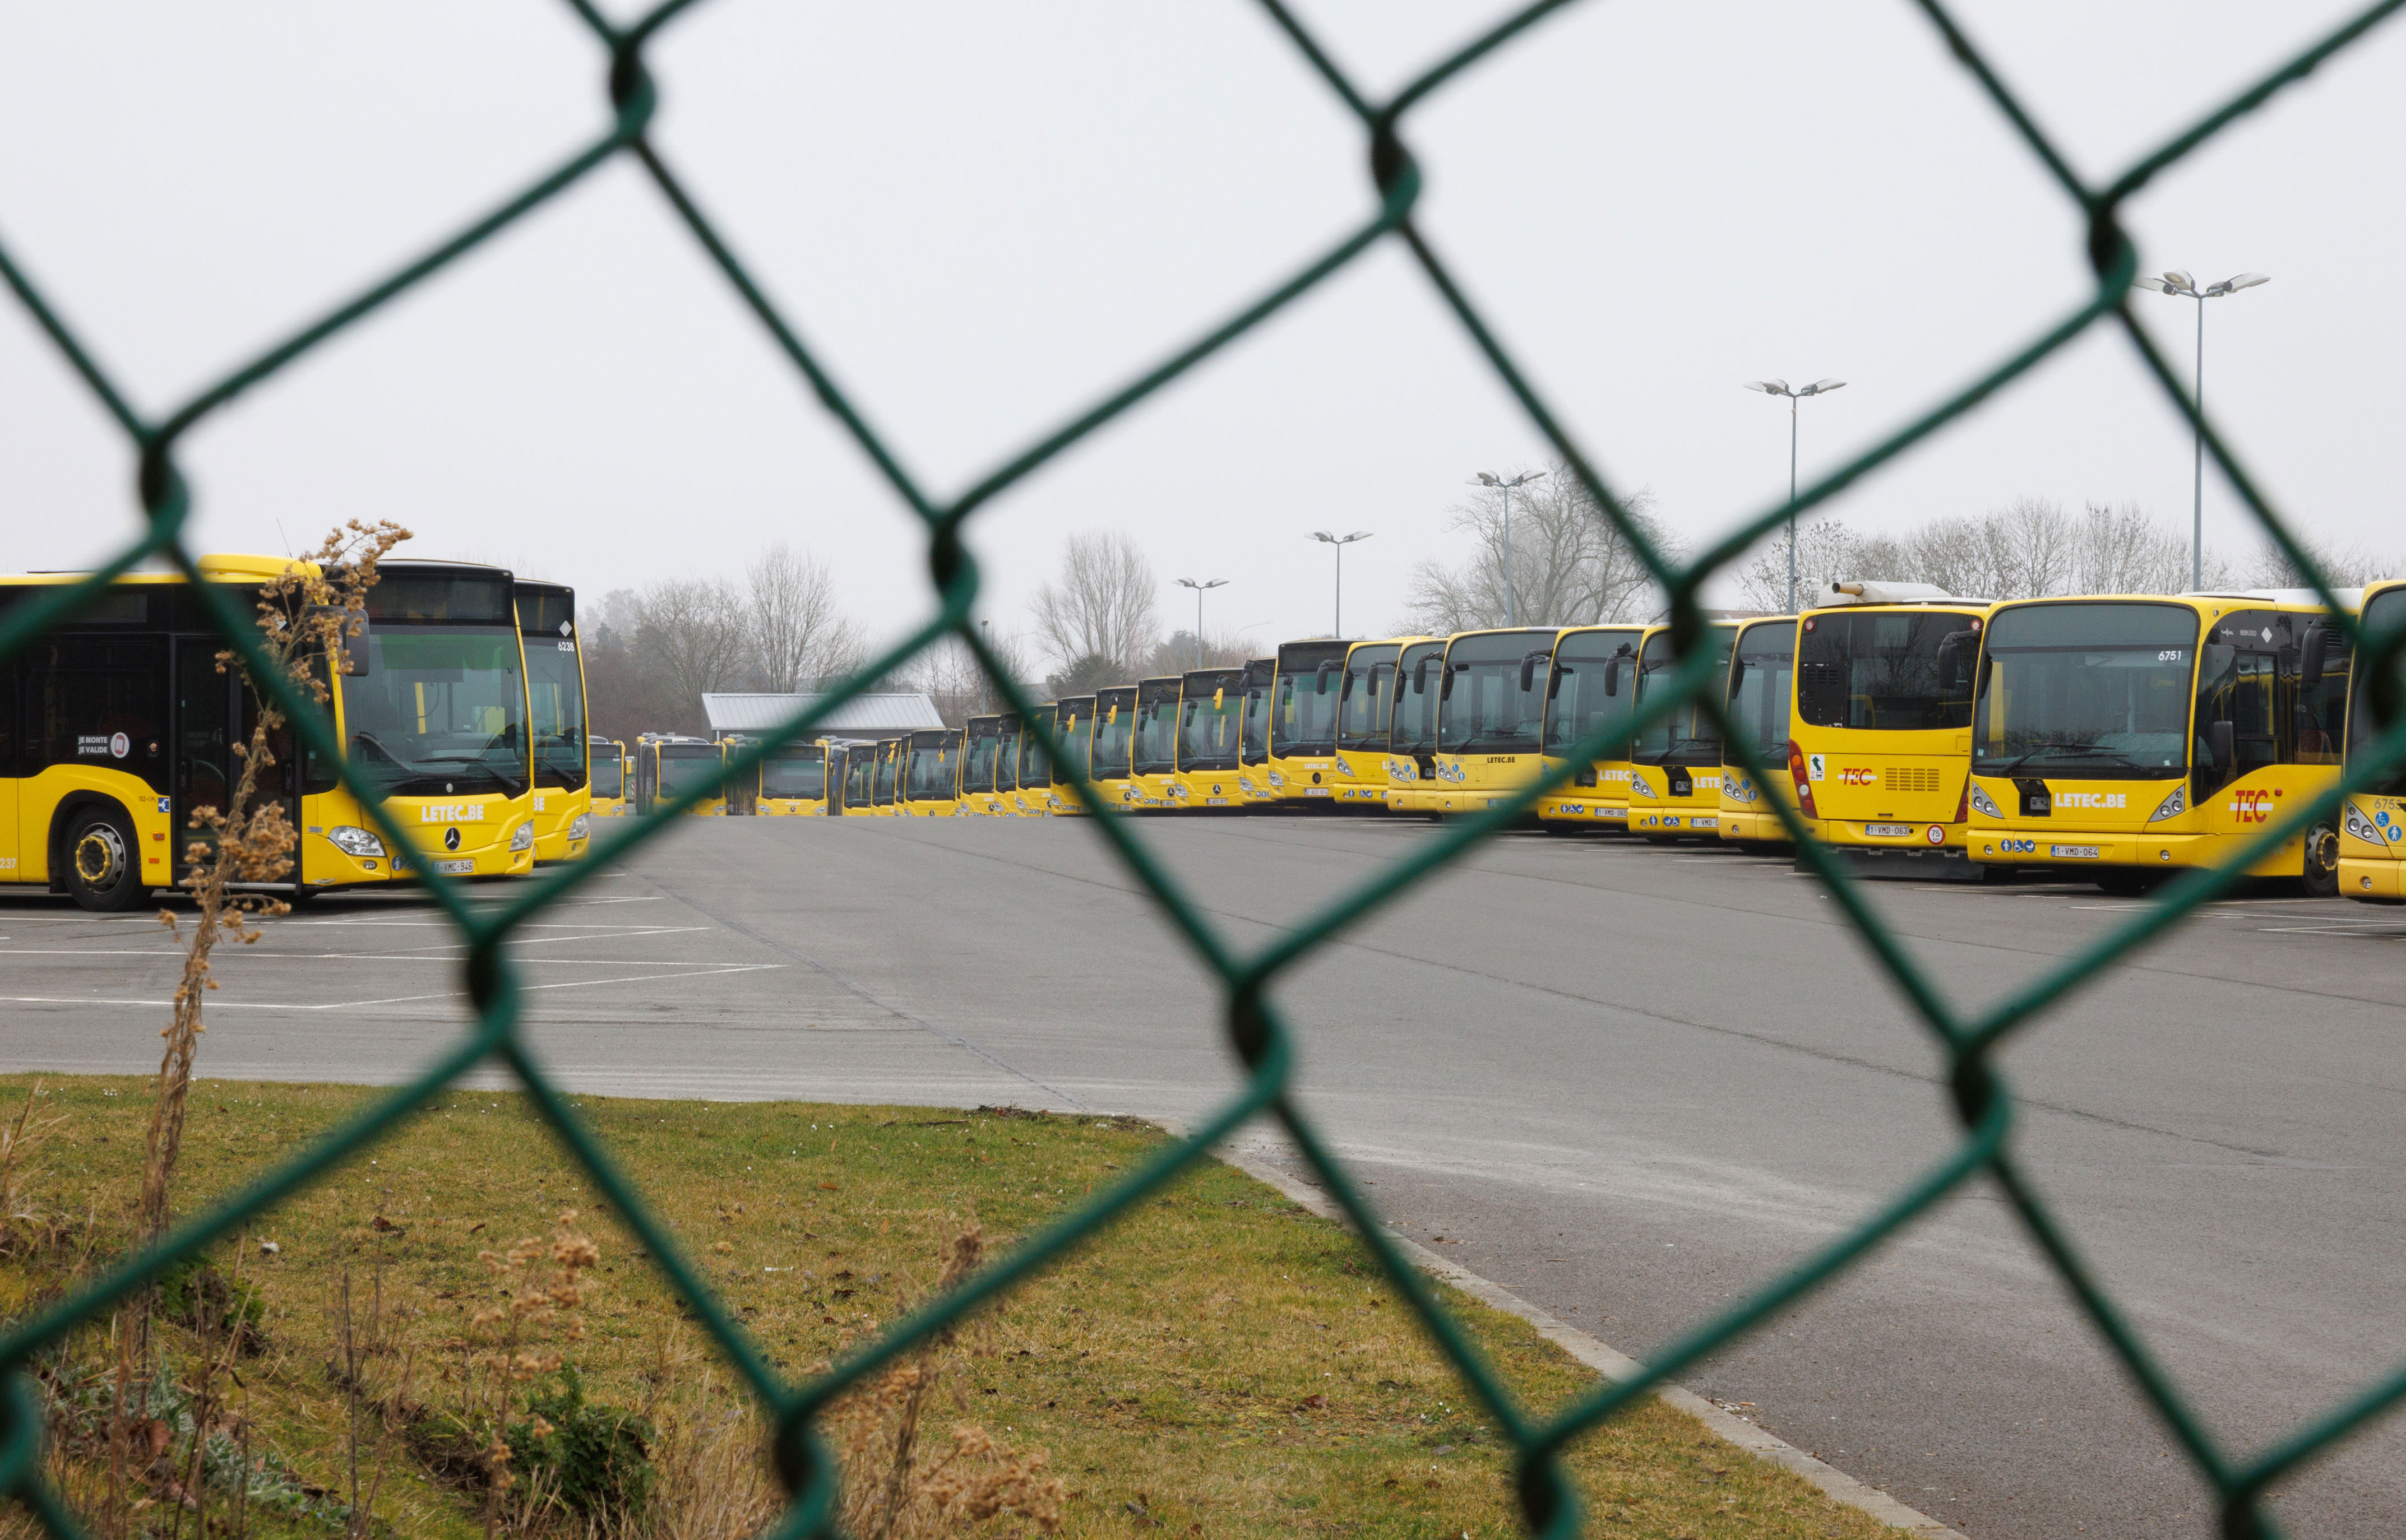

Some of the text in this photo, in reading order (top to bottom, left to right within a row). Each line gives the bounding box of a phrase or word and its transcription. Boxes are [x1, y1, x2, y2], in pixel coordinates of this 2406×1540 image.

[558, 641, 575, 652] 6238
[2158, 651, 2182, 661] 6751
[1599, 769, 1630, 781] LETEC
[1843, 768, 1872, 786] TEC
[1694, 777, 1721, 788] LETE
[2055, 793, 2126, 808] LETEC.BE
[2235, 789, 2269, 823] TEC
[422, 804, 484, 823] LETEC.BE
[1870, 826, 1908, 834] 1-VMD-063
[2056, 847, 2098, 856] 1-VMD-064
[436, 862, 473, 872] 1-VMC-946
